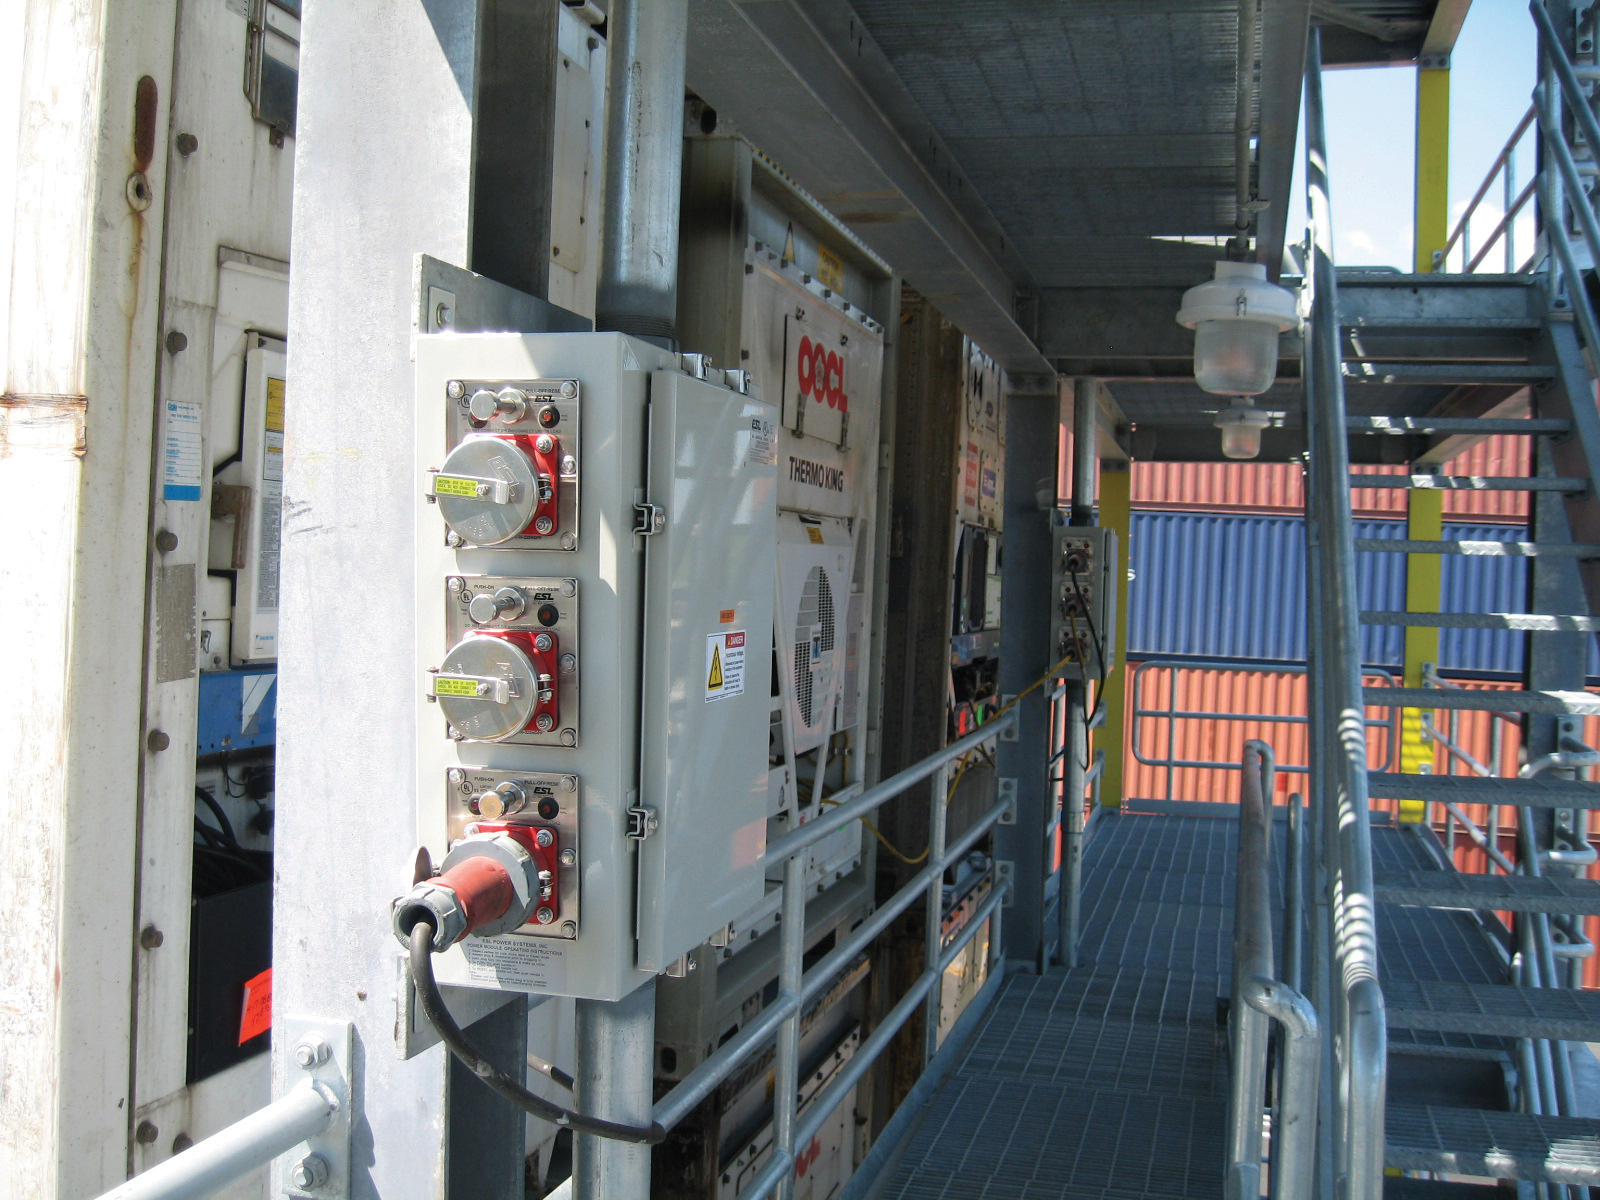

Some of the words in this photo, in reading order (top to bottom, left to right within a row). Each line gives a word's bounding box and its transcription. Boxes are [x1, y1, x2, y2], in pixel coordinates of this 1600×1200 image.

[798, 335, 848, 413] OOCL
[534, 395, 556, 403] ESL
[789, 455, 825, 488] THERMO
[825, 466, 844, 492] KING
[533, 592, 554, 601] ESL
[533, 786, 554, 795] ESL
[530, 948, 563, 956] INSTRUCTIONS
